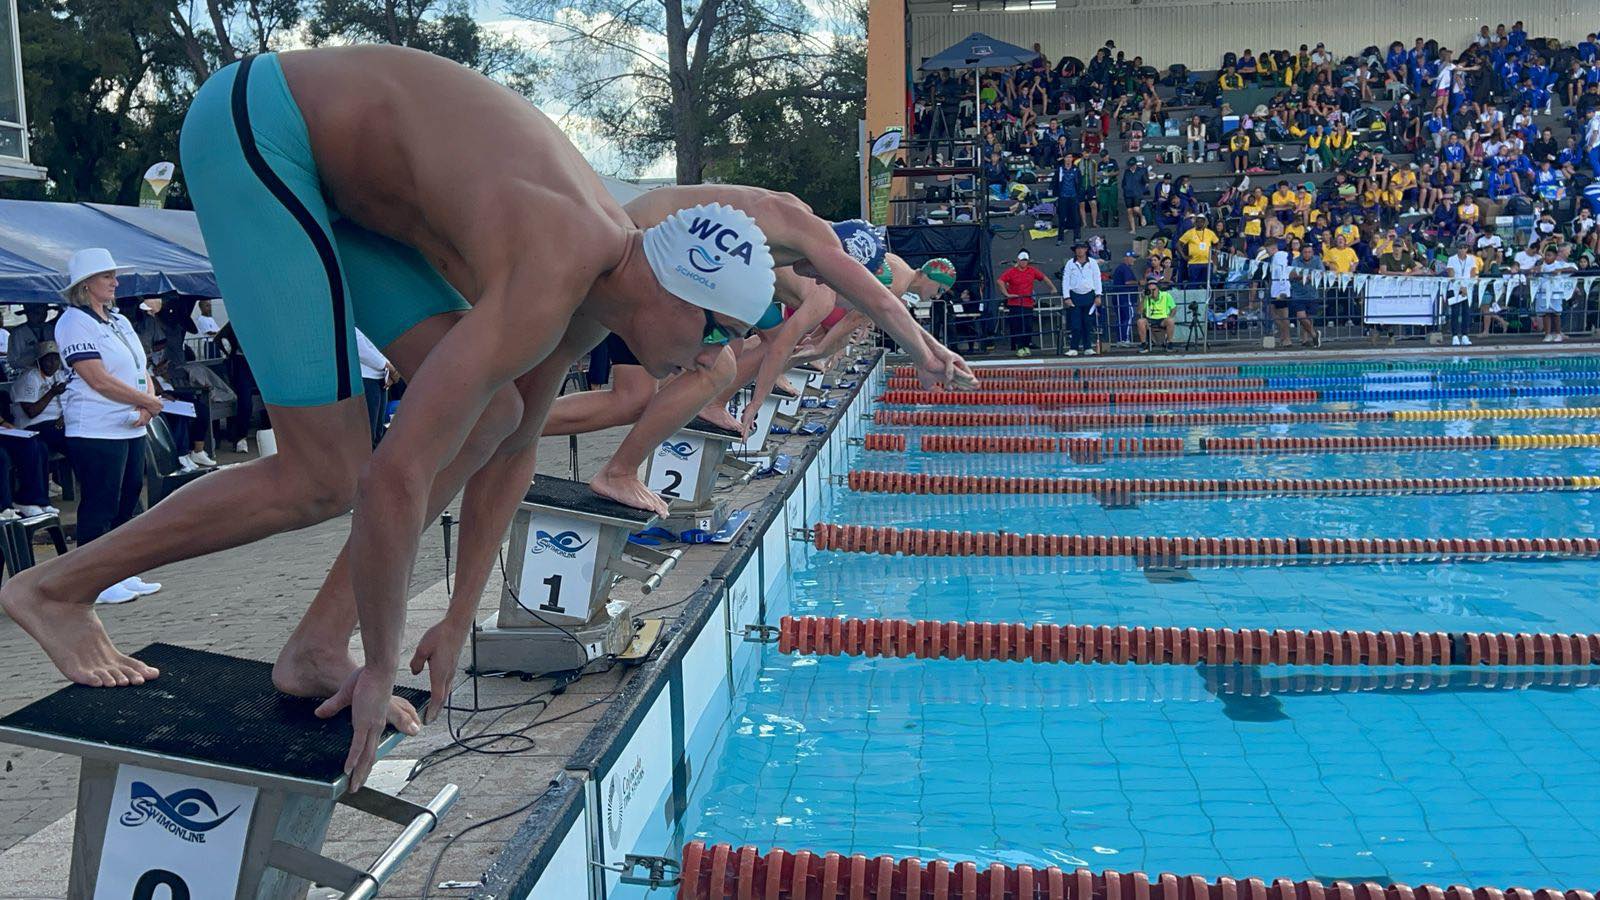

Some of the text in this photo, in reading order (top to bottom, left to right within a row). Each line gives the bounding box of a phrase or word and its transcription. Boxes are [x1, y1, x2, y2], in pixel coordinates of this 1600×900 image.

[688, 217, 752, 265] WCA
[675, 265, 716, 289] SCHOOLS
[660, 469, 683, 498] 2
[539, 574, 566, 614] 1
[590, 643, 597, 653] 1
[120, 797, 207, 844] SWIMONLINE
